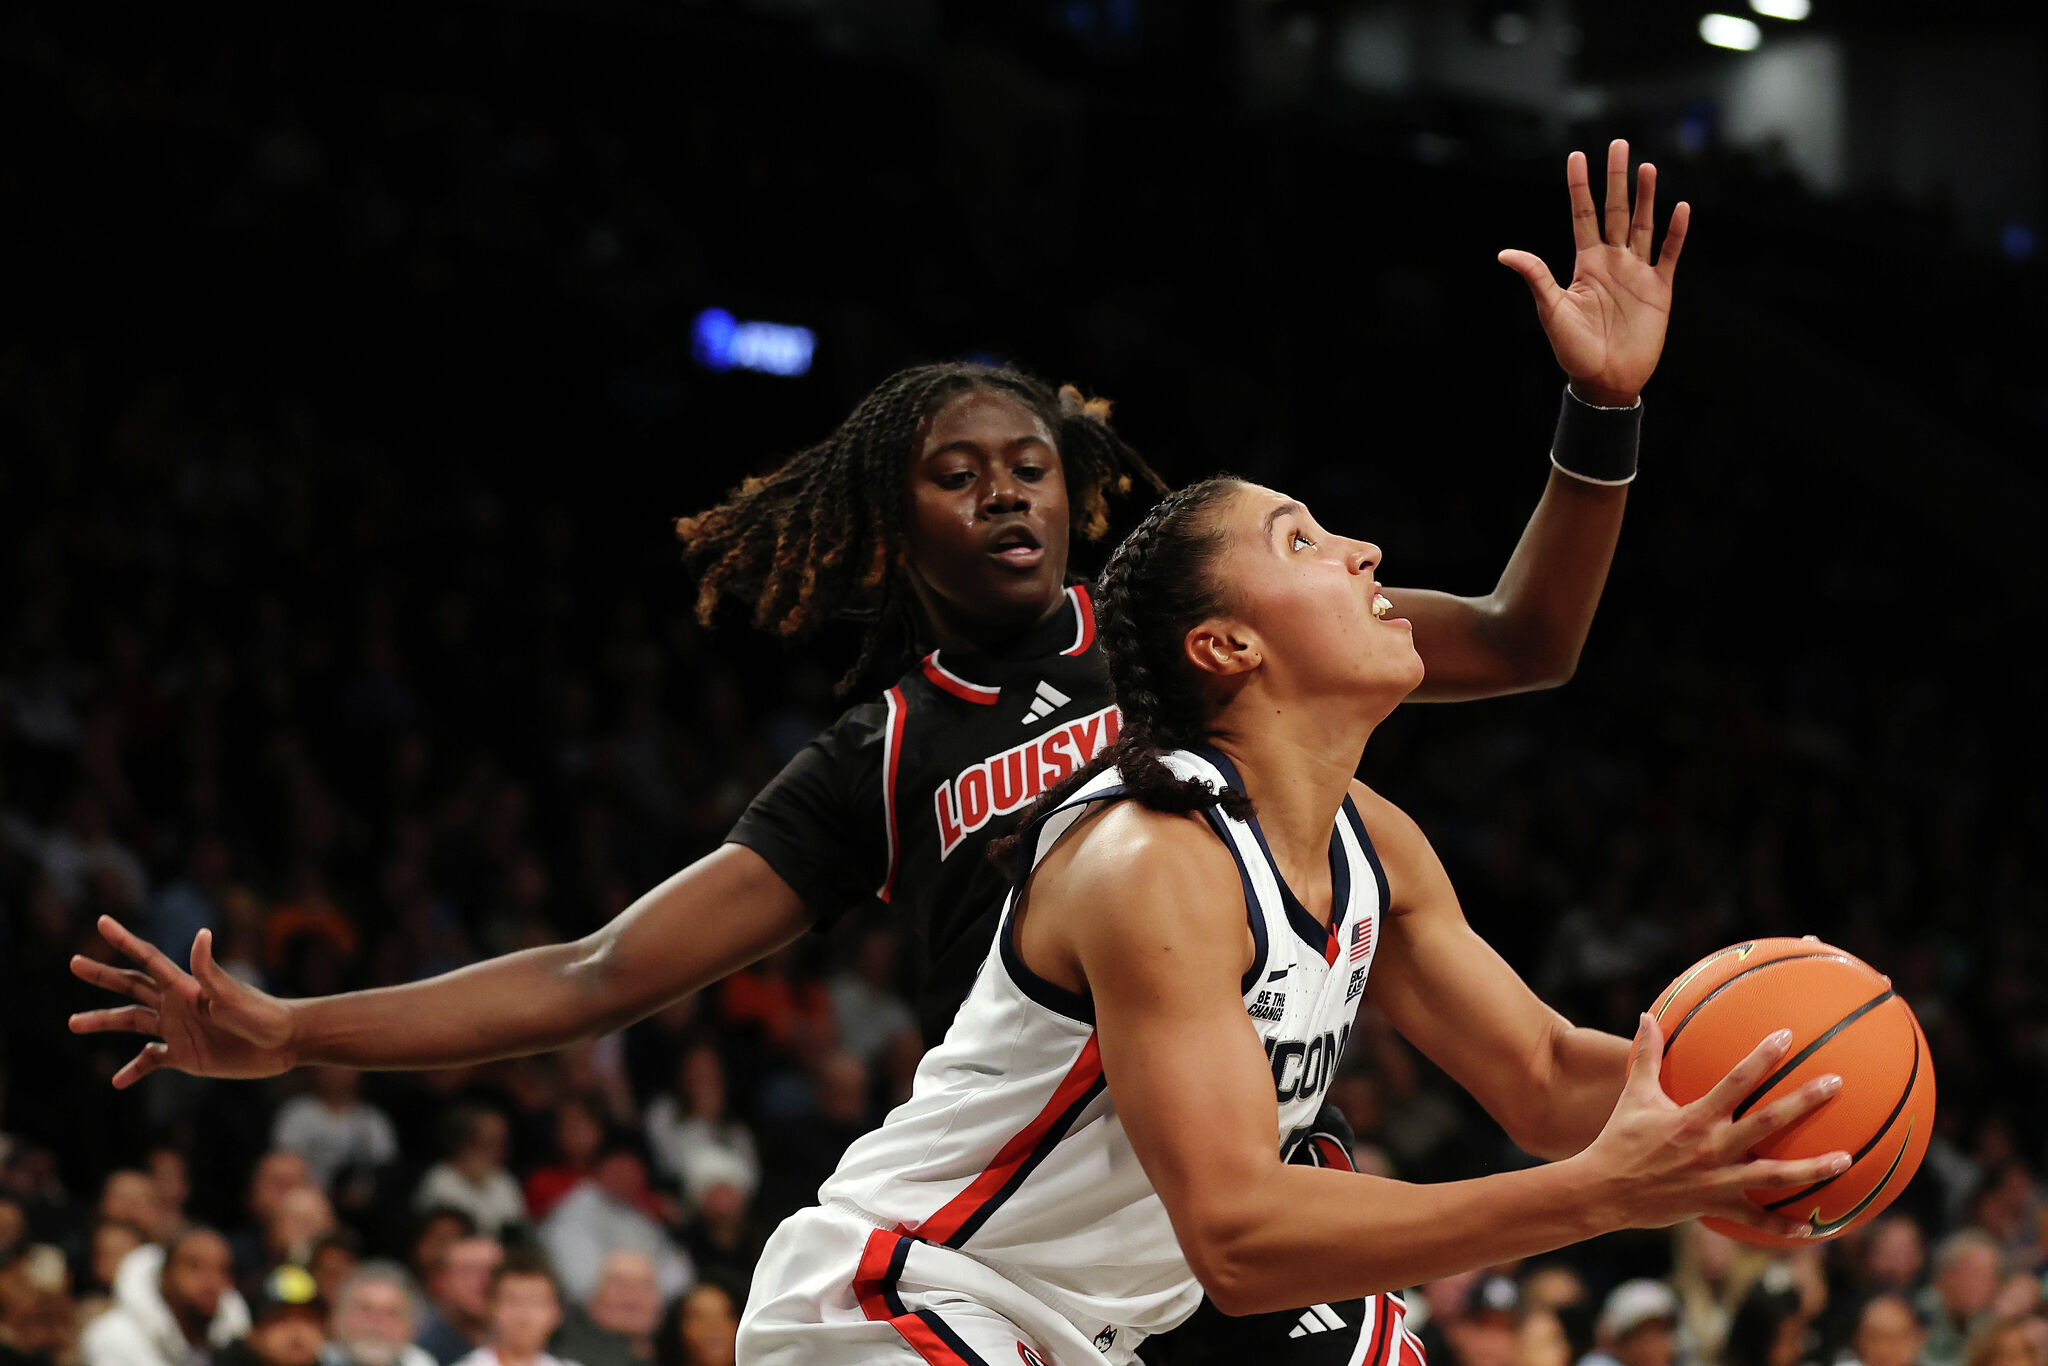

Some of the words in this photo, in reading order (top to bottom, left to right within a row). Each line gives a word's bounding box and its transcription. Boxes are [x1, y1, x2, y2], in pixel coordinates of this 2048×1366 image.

[1257, 990, 1271, 1005] BE
[1272, 992, 1286, 1007] THE
[1248, 1003, 1284, 1021] CHANGE
